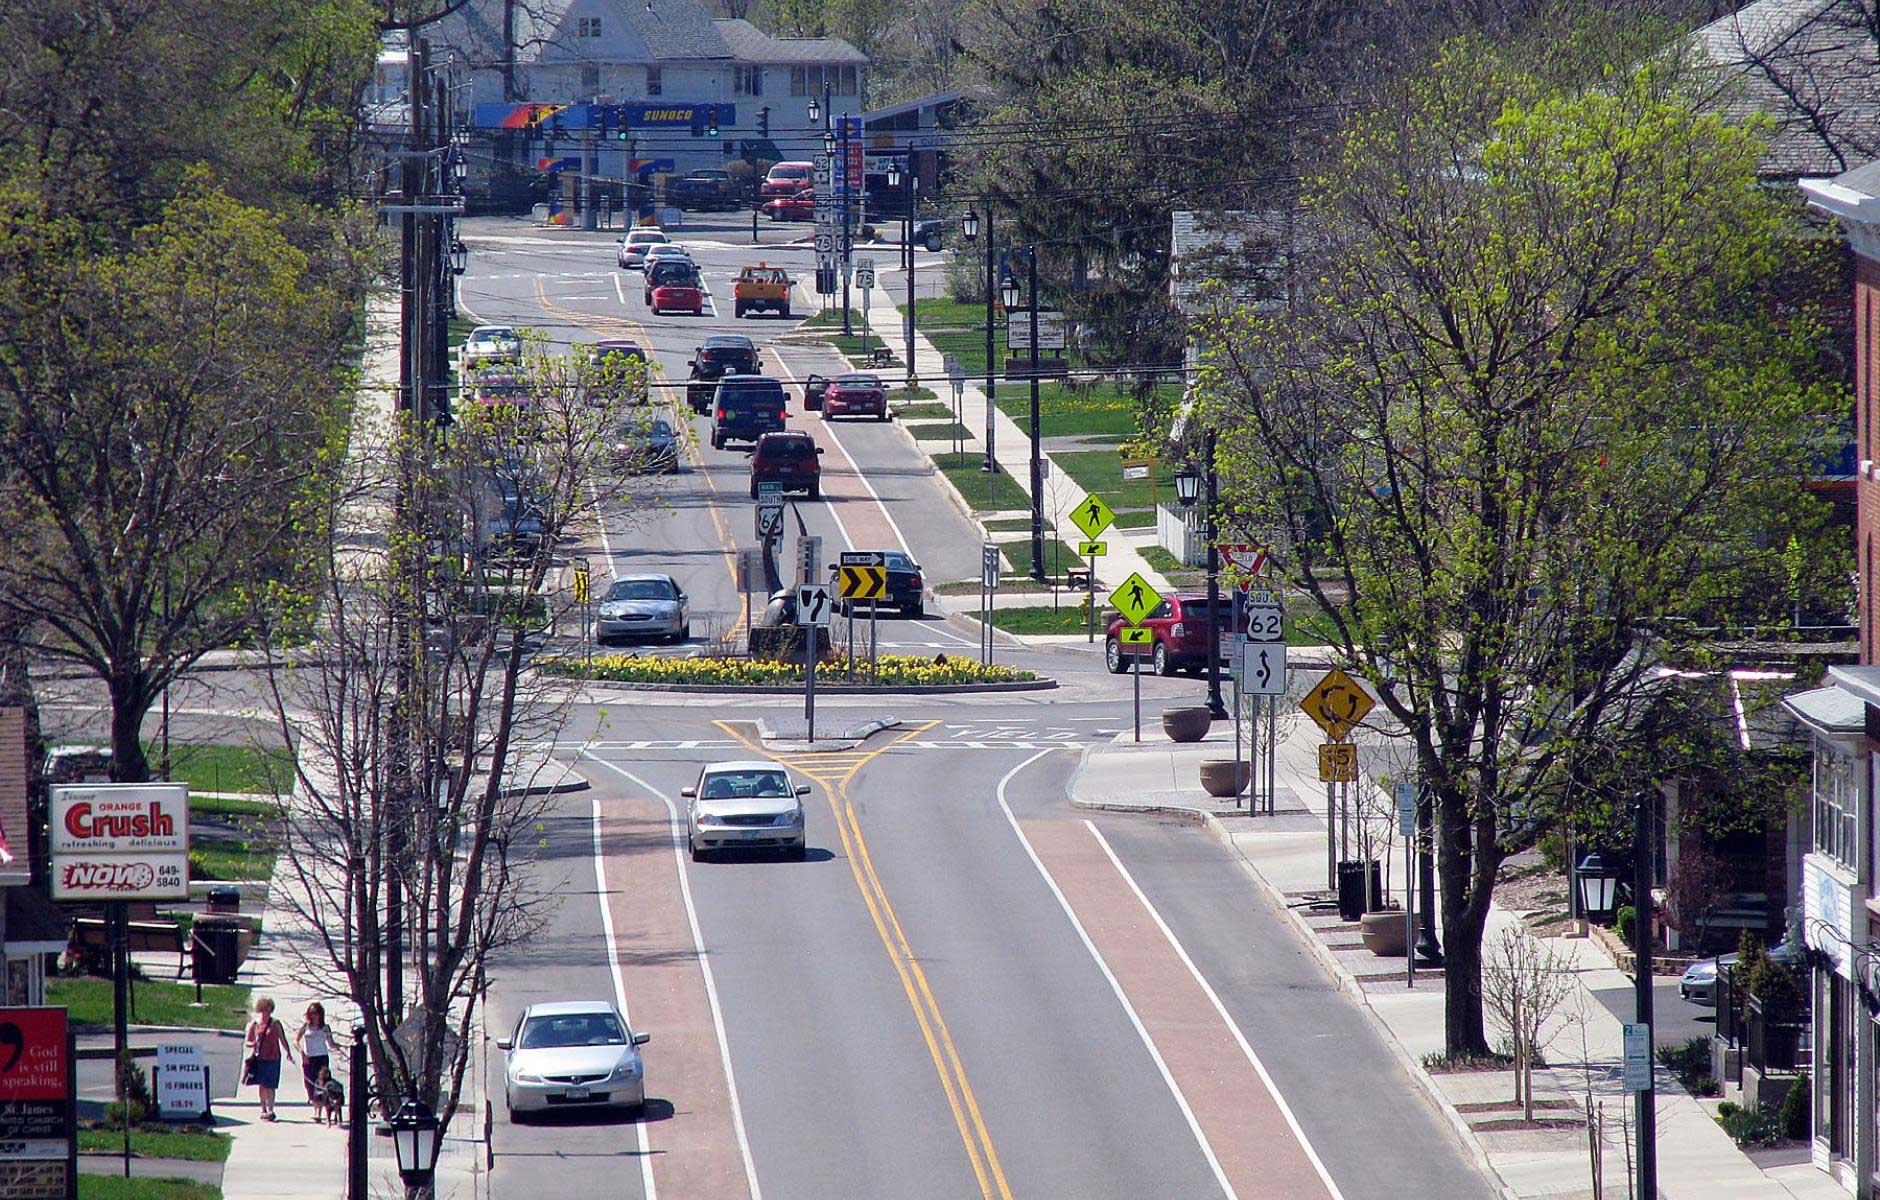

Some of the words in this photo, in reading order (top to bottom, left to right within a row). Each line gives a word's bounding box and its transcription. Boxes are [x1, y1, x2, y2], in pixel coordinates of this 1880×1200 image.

[643, 110, 694, 121] SUNOCO
[815, 158, 828, 169] 62
[816, 239, 830, 249] 75
[858, 274, 873, 285] 75
[760, 494, 782, 504] SOUTH
[1251, 615, 1279, 634] 62
[950, 729, 1080, 740] YIELD
[98, 802, 142, 811] ORANGE
[64, 801, 174, 839] Crush
[61, 839, 116, 849] refreshing
[128, 839, 177, 847] delicious
[158, 865, 180, 876] 649-
[156, 877, 180, 888] 5840
[1625, 1026, 1632, 1036] 2
[29, 1045, 58, 1057] God
[164, 1046, 194, 1054] SPECIAL
[19, 1061, 29, 1072] is
[33, 1060, 58, 1073] still
[179, 1064, 200, 1072] PIZZA
[173, 1082, 203, 1090] FINGERS
[21, 1102, 54, 1115] James
